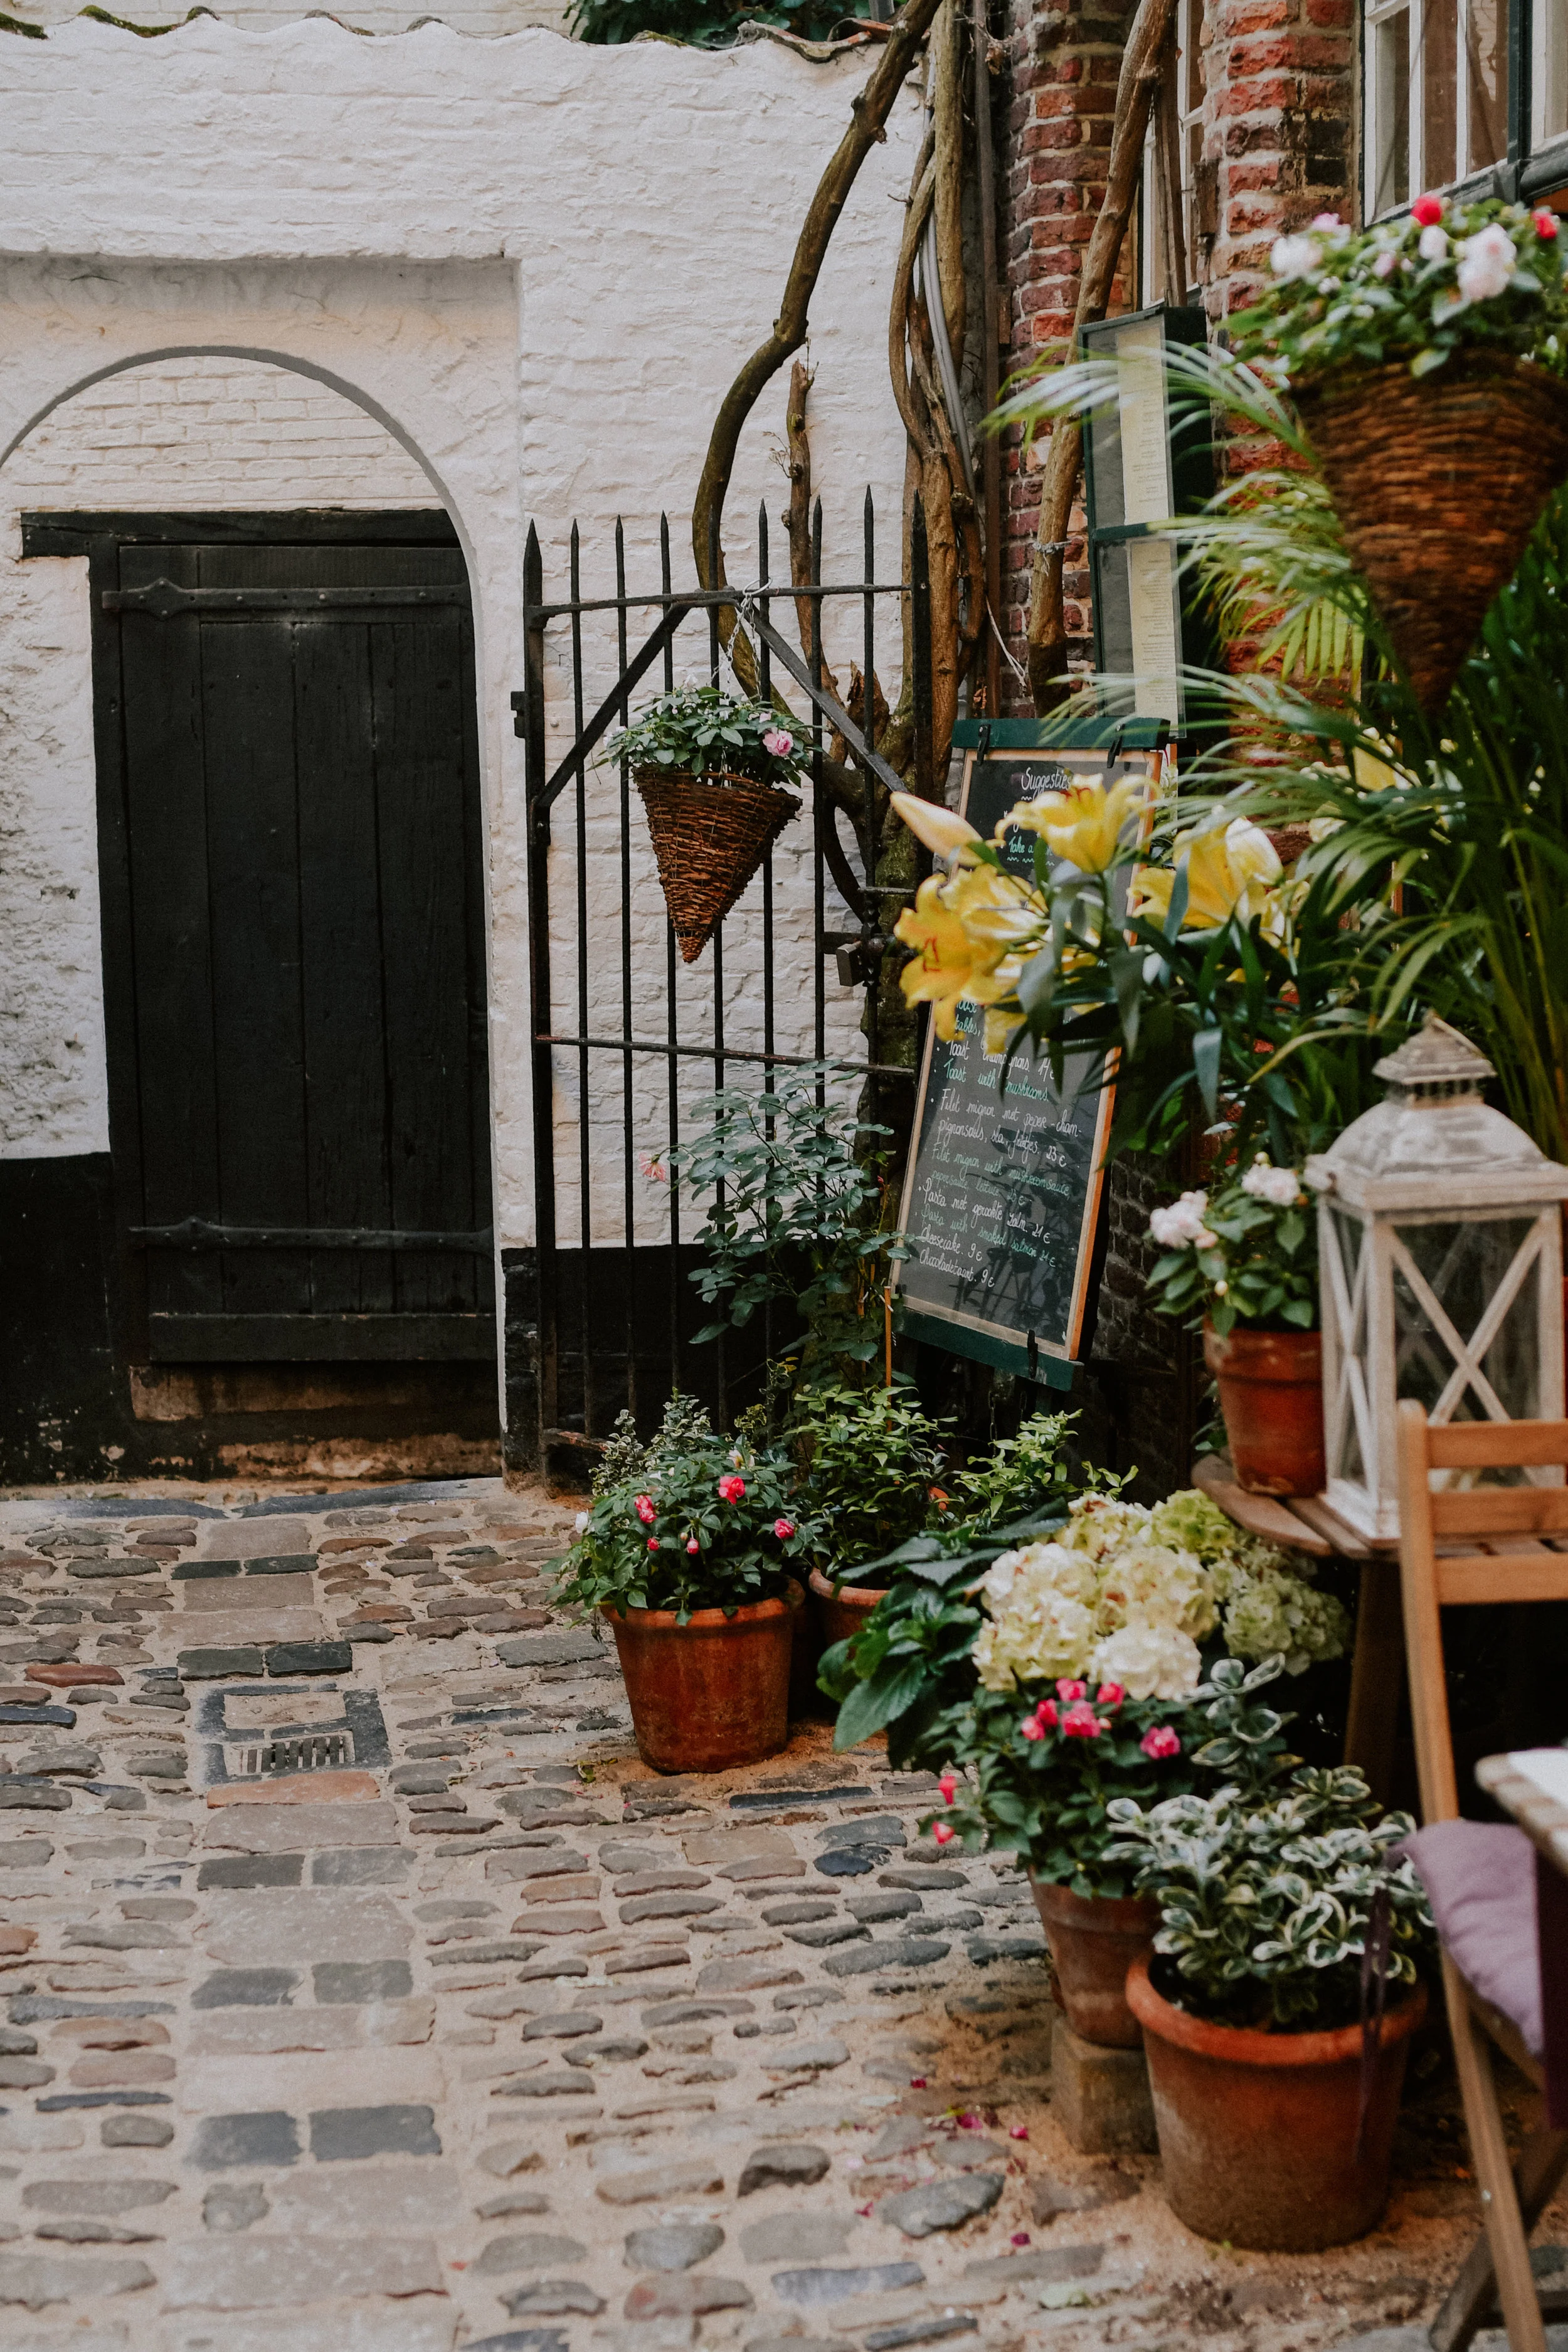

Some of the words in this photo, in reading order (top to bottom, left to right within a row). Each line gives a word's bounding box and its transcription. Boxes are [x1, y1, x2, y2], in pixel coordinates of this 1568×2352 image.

[1021, 767, 1071, 801] Suggesties
[1009, 835, 1025, 854] Take
[956, 1000, 977, 1014] oast
[946, 1039, 970, 1061] Toast
[982, 1052, 1030, 1079] campgnons.
[943, 1057, 967, 1083] Toast
[977, 1068, 996, 1089] with
[1005, 1075, 1049, 1102] mushrooms.
[940, 1088, 960, 1113] Filet
[966, 1099, 995, 1131] mignon
[1002, 1106, 1021, 1122] met
[932, 1146, 950, 1162] Filet
[953, 1153, 980, 1181] mignon
[984, 1157, 1004, 1175] with
[1046, 1146, 1057, 1161] 23
[922, 1177, 946, 1207] Pasta
[951, 1194, 967, 1210] met
[971, 1200, 1003, 1229] gerookte
[1032, 1224, 1043, 1237] 21
[921, 1204, 945, 1227] Pasta
[950, 1213, 968, 1232] with
[978, 1224, 1006, 1246] smoked
[1011, 1238, 1037, 1257] salmon
